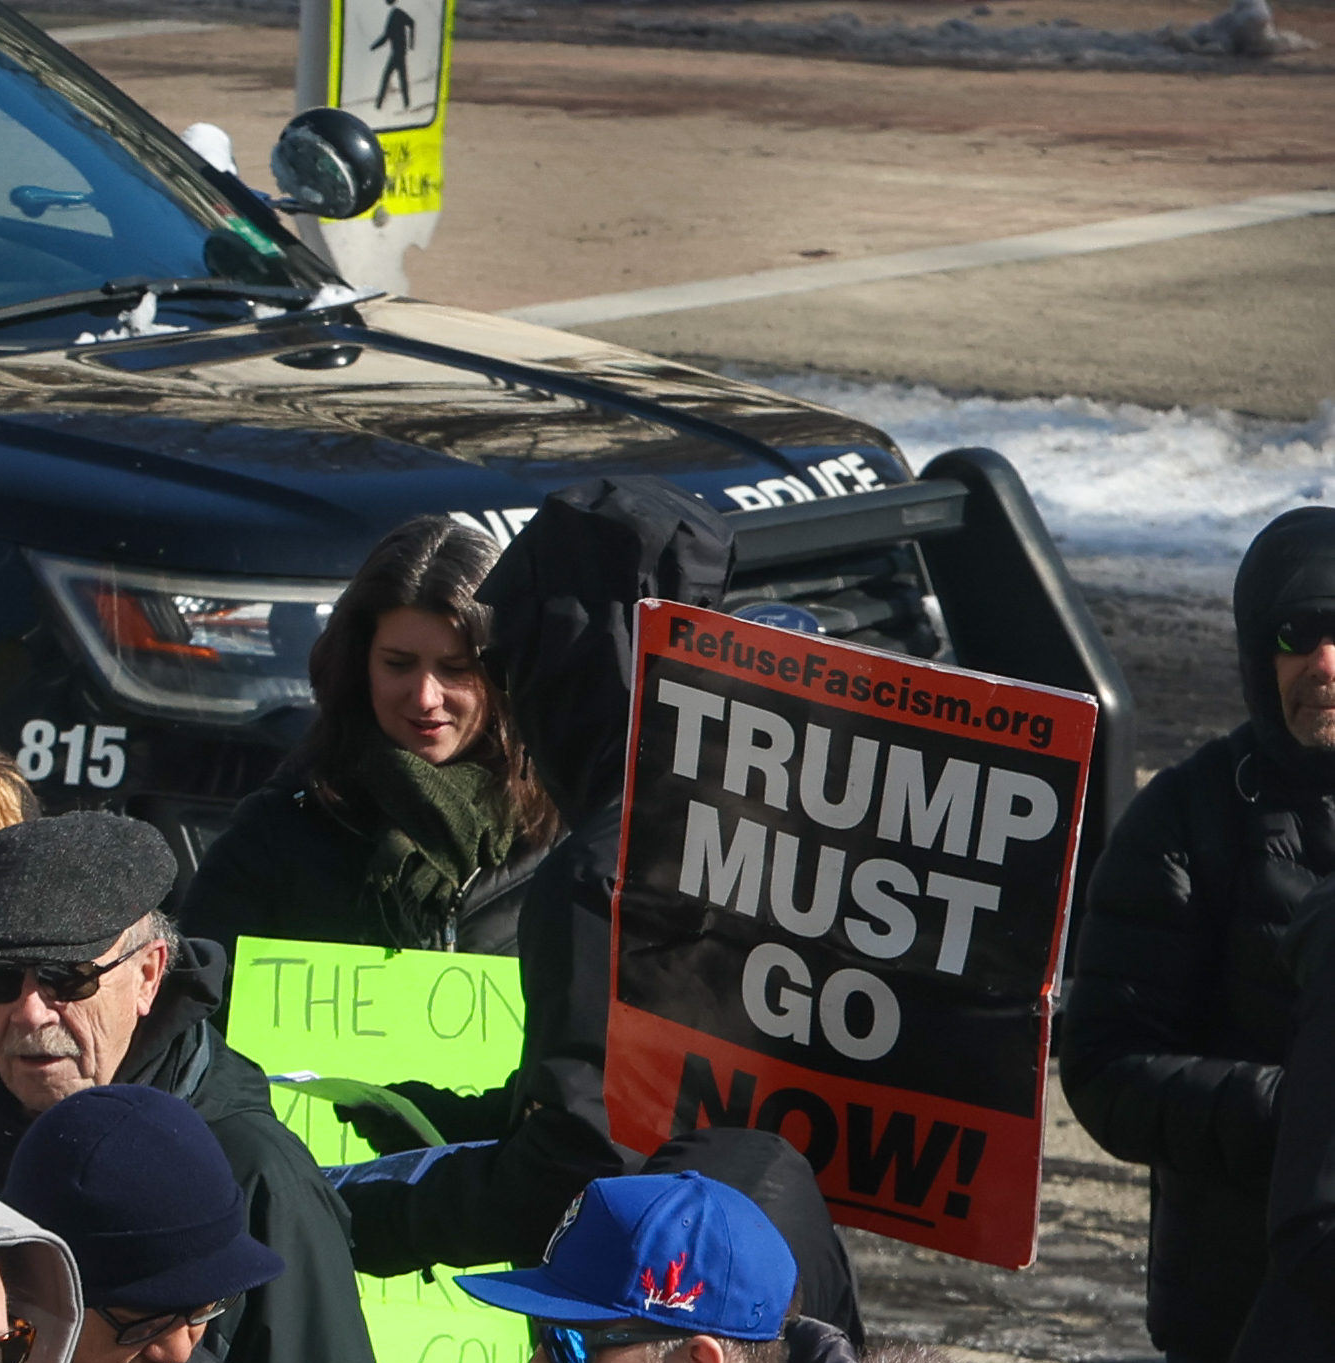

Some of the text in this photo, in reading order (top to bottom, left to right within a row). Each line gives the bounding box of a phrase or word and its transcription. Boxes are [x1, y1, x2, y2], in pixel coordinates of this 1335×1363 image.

[668, 616, 1053, 749] RefuseFascism.org
[16, 719, 127, 788] 815
[656, 678, 1059, 866] TRUMP
[677, 800, 1001, 976] MUST
[251, 956, 387, 1039] THE
[741, 942, 900, 1062] GO
[668, 1052, 987, 1220] NOW!
